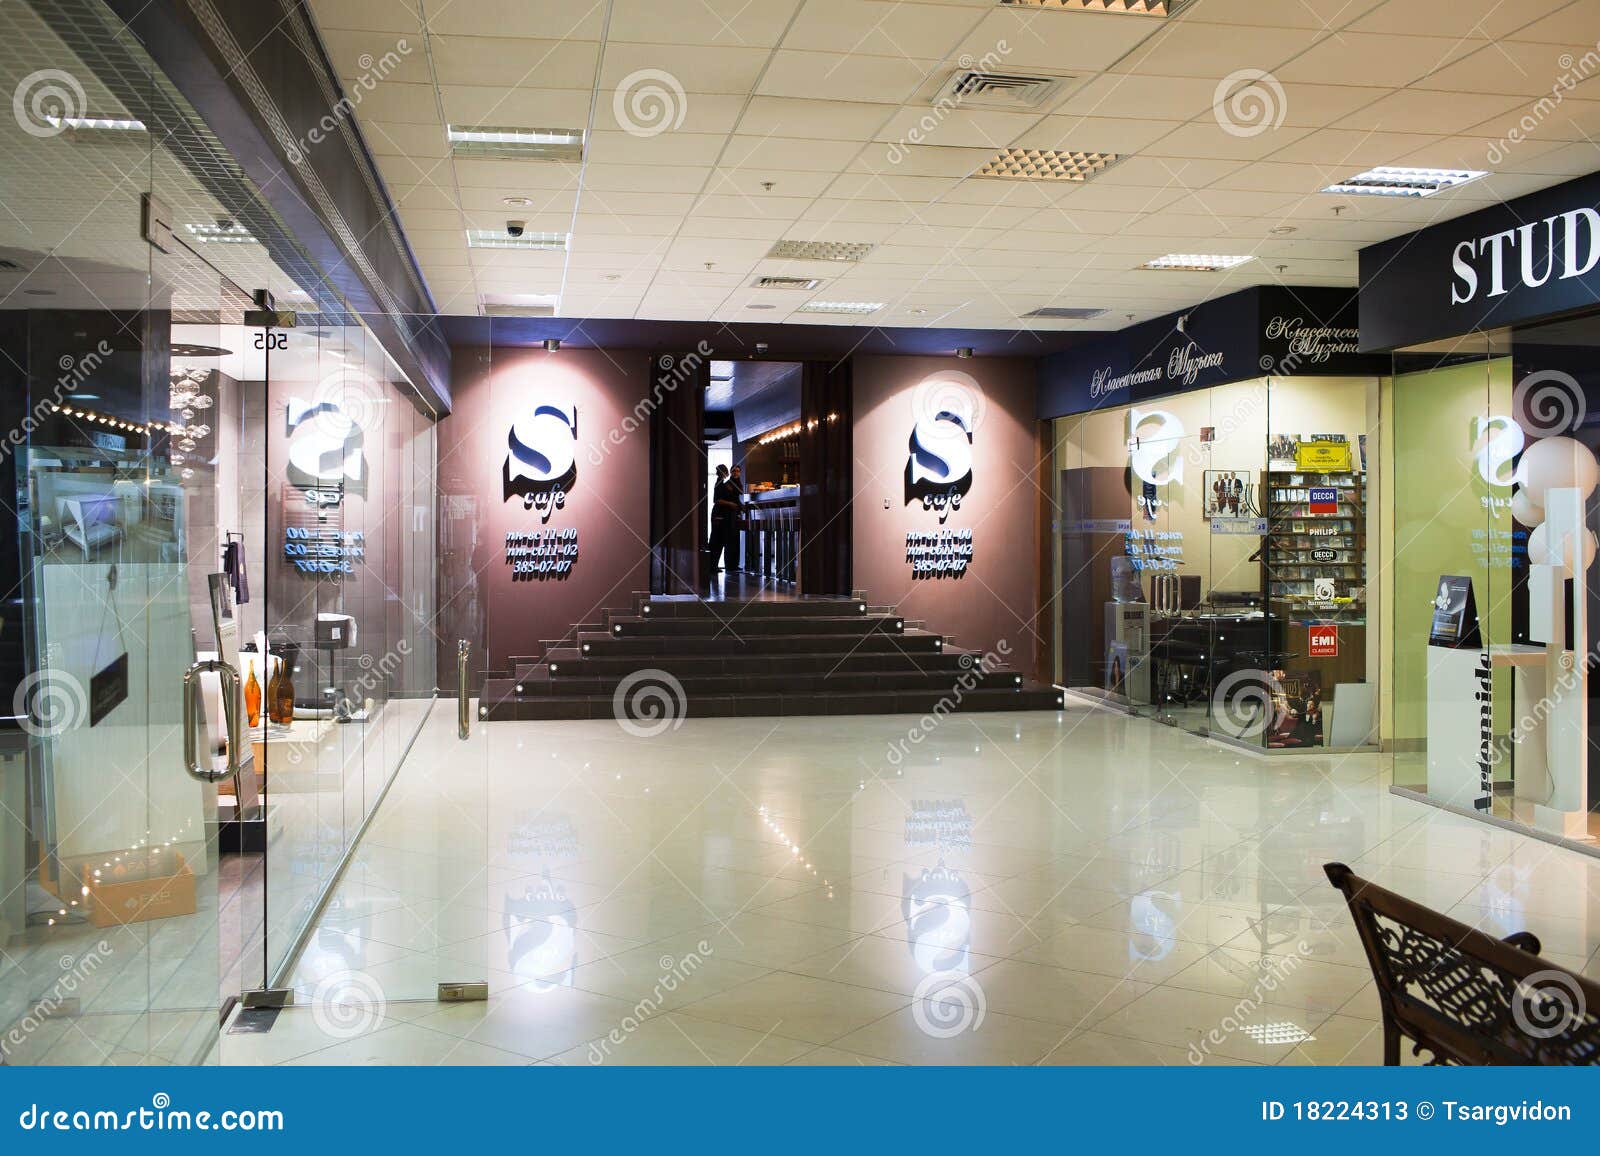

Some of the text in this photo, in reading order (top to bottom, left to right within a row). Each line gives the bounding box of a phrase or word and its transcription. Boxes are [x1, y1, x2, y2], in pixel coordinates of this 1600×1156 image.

[1451, 207, 1600, 306] STUD
[1167, 341, 1224, 385] Музыка
[504, 399, 577, 490] S
[906, 403, 973, 494] S
[524, 483, 566, 518] cafe
[924, 485, 962, 519] cafe
[1312, 492, 1335, 501] DECCA
[544, 528, 577, 540] 11-00
[513, 560, 572, 574] 385-07-07
[1312, 636, 1335, 646] EMI
